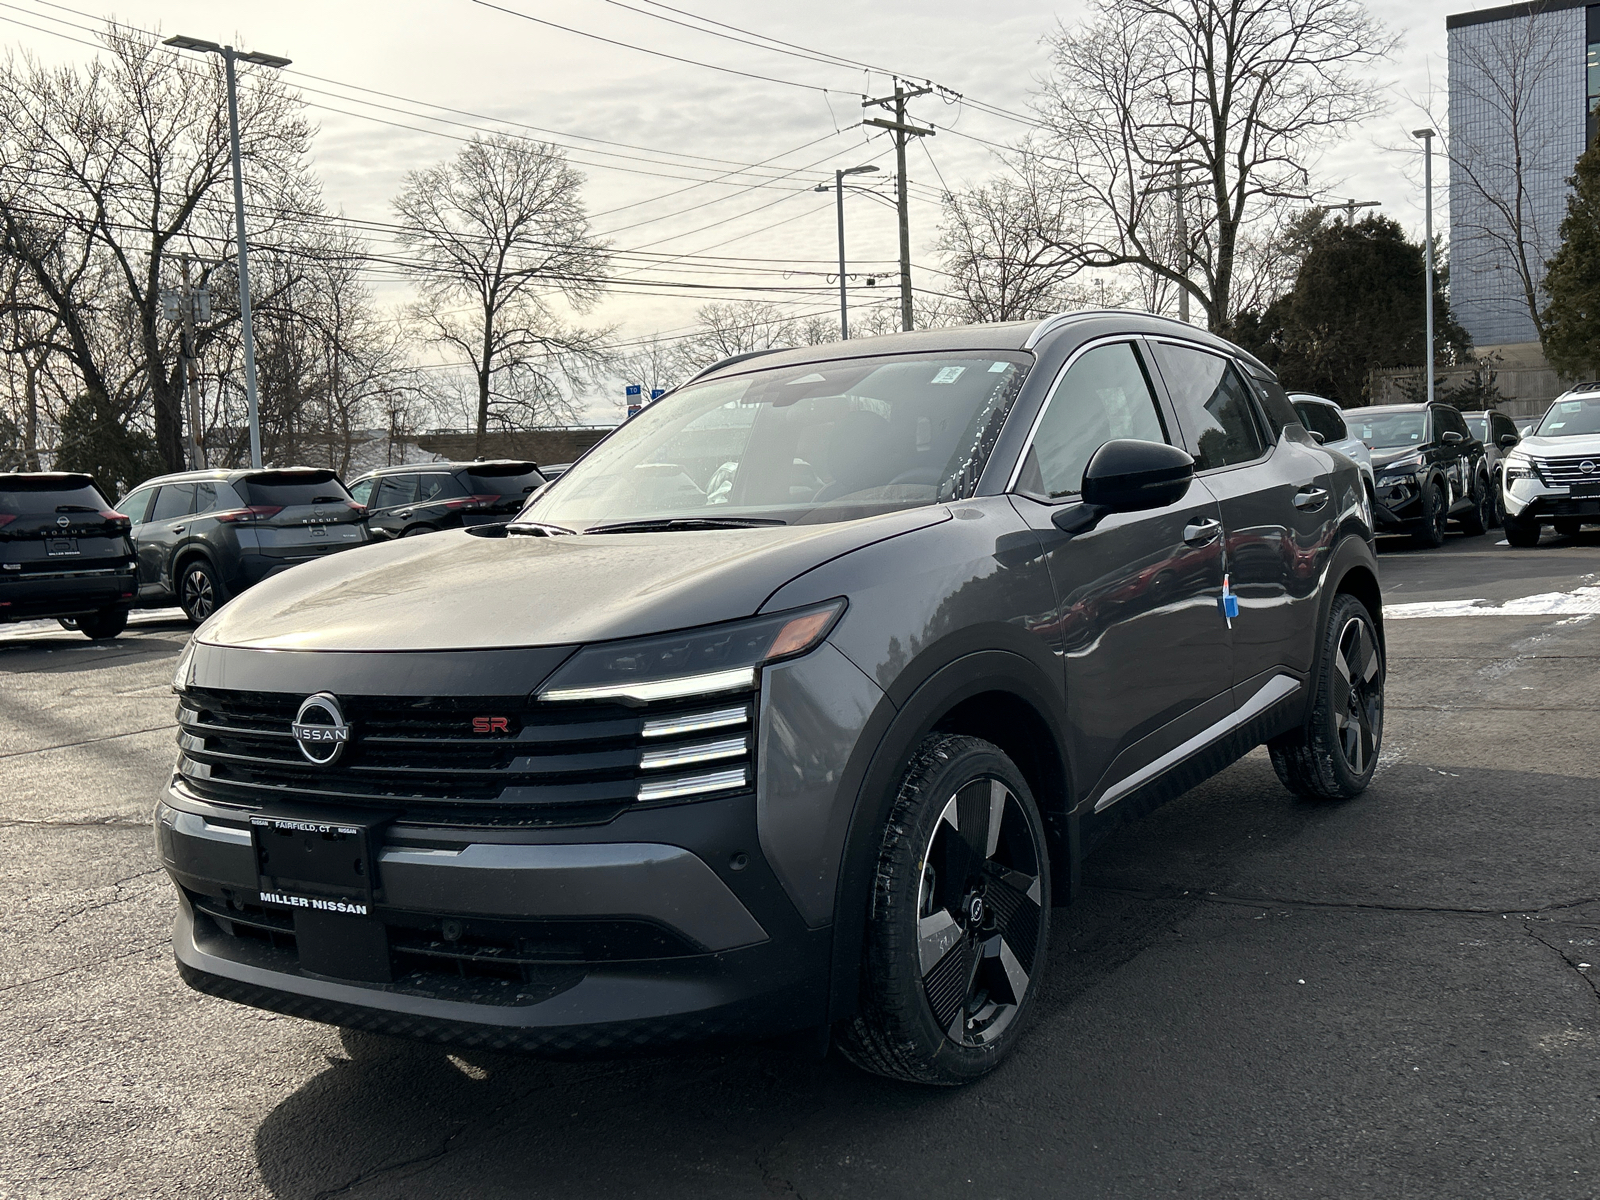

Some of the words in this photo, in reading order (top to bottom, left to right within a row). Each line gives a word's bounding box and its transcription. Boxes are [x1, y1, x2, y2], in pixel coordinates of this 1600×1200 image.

[472, 717, 509, 733] SR
[292, 726, 347, 740] NISSAN
[275, 821, 318, 833] FAIRFIELD,
[319, 825, 331, 833] CT
[338, 827, 357, 835] NISSAN
[260, 892, 309, 908] MILLER
[312, 899, 367, 915] NISSAN
